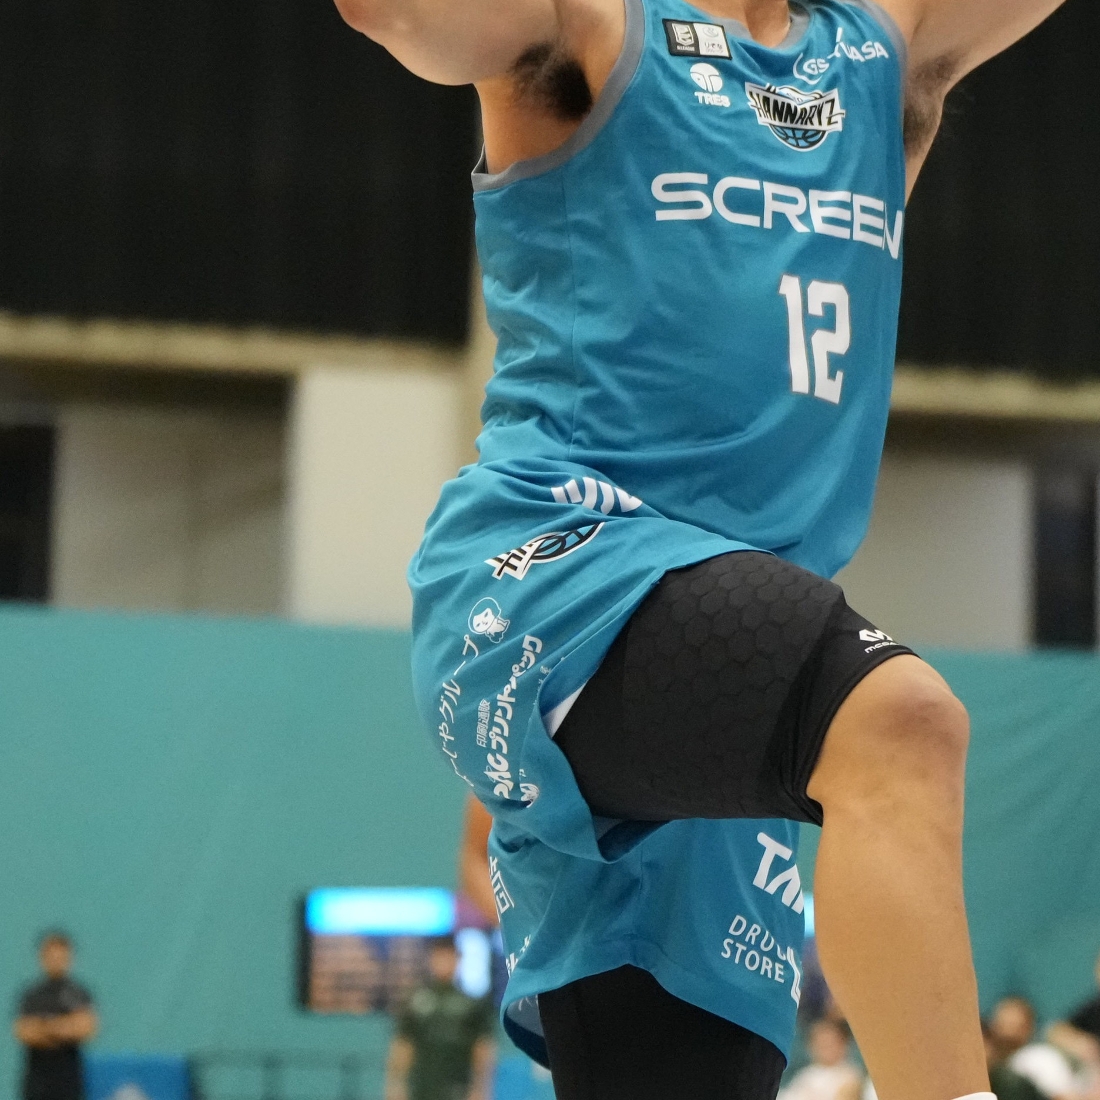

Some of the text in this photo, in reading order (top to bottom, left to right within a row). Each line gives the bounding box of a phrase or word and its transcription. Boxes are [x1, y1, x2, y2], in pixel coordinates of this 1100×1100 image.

[694, 91, 731, 108] TRES
[748, 90, 845, 126] HANNARYZ
[650, 172, 903, 260] SCREEN
[778, 273, 851, 405] 12
[721, 938, 785, 984] STORE
